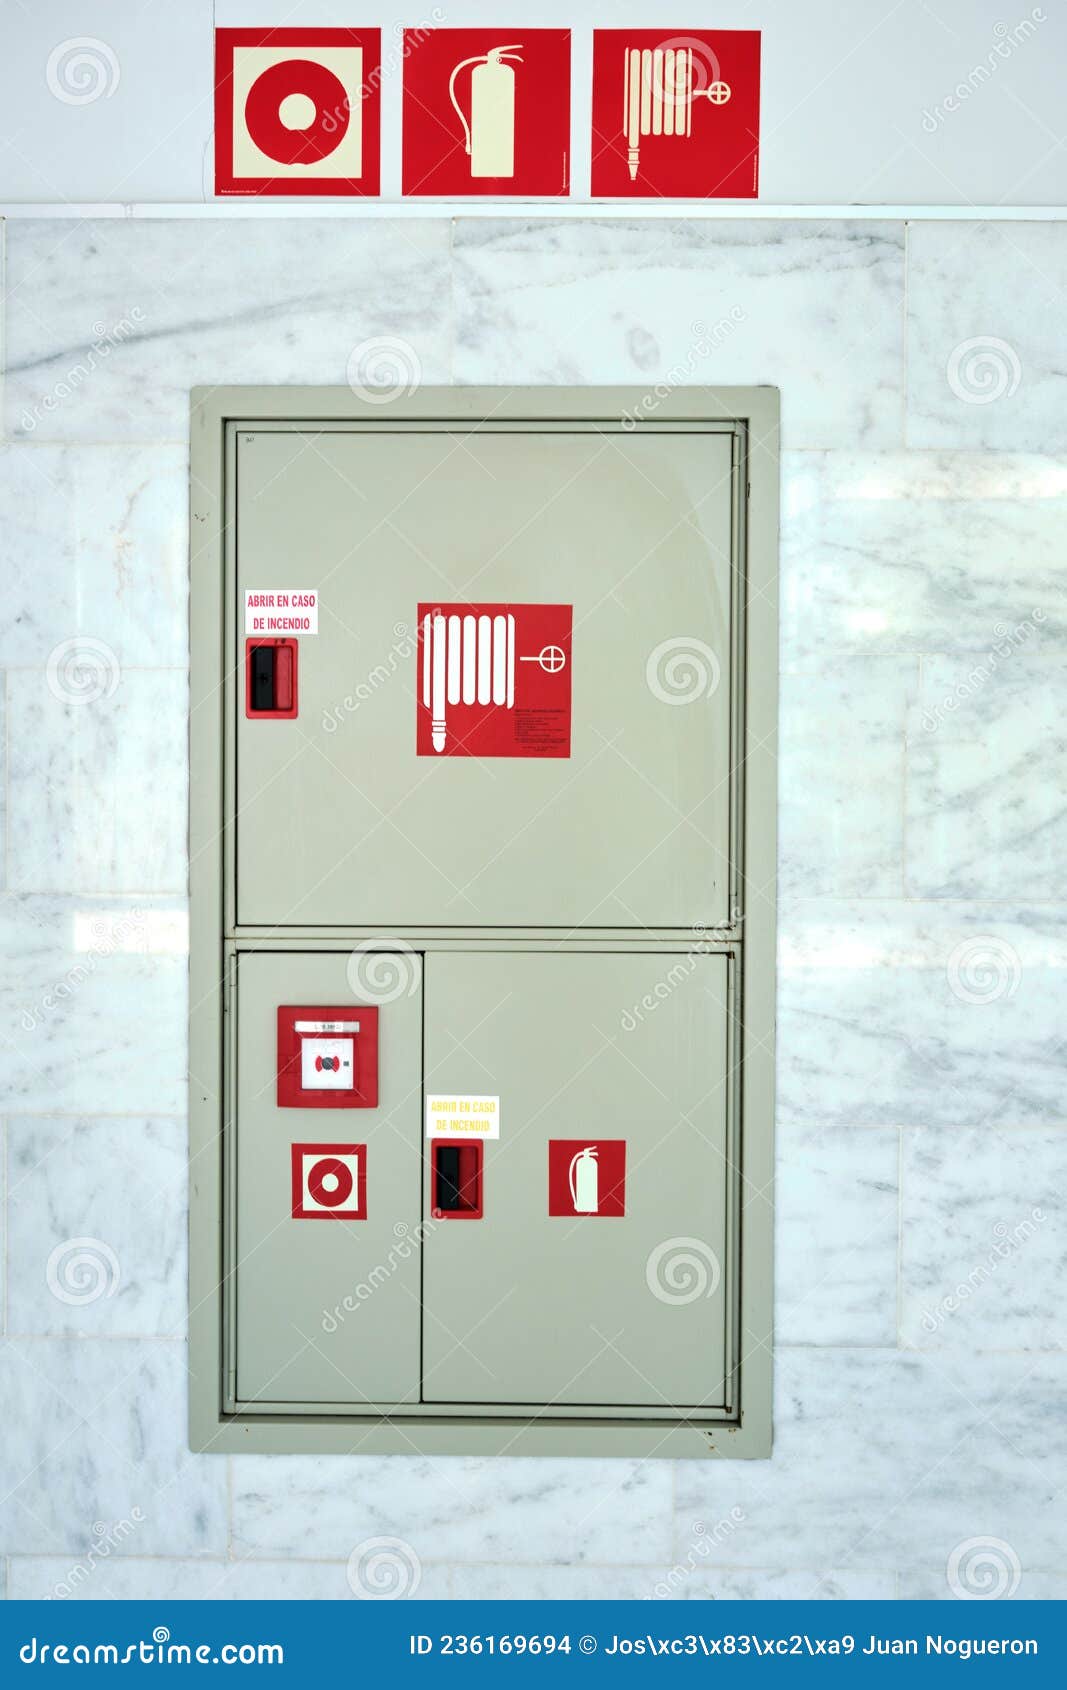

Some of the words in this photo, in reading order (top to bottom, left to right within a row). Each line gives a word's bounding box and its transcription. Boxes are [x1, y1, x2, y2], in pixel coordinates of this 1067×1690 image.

[248, 595, 274, 607] ABRIR
[277, 595, 289, 607] EN
[292, 595, 316, 607] CASO
[253, 617, 265, 630] DE
[267, 617, 310, 630] INCENDIO
[459, 1101, 470, 1112] EN
[472, 1101, 496, 1112] CASO
[436, 1119, 447, 1130] DE
[450, 1119, 490, 1131] INCENDIO
